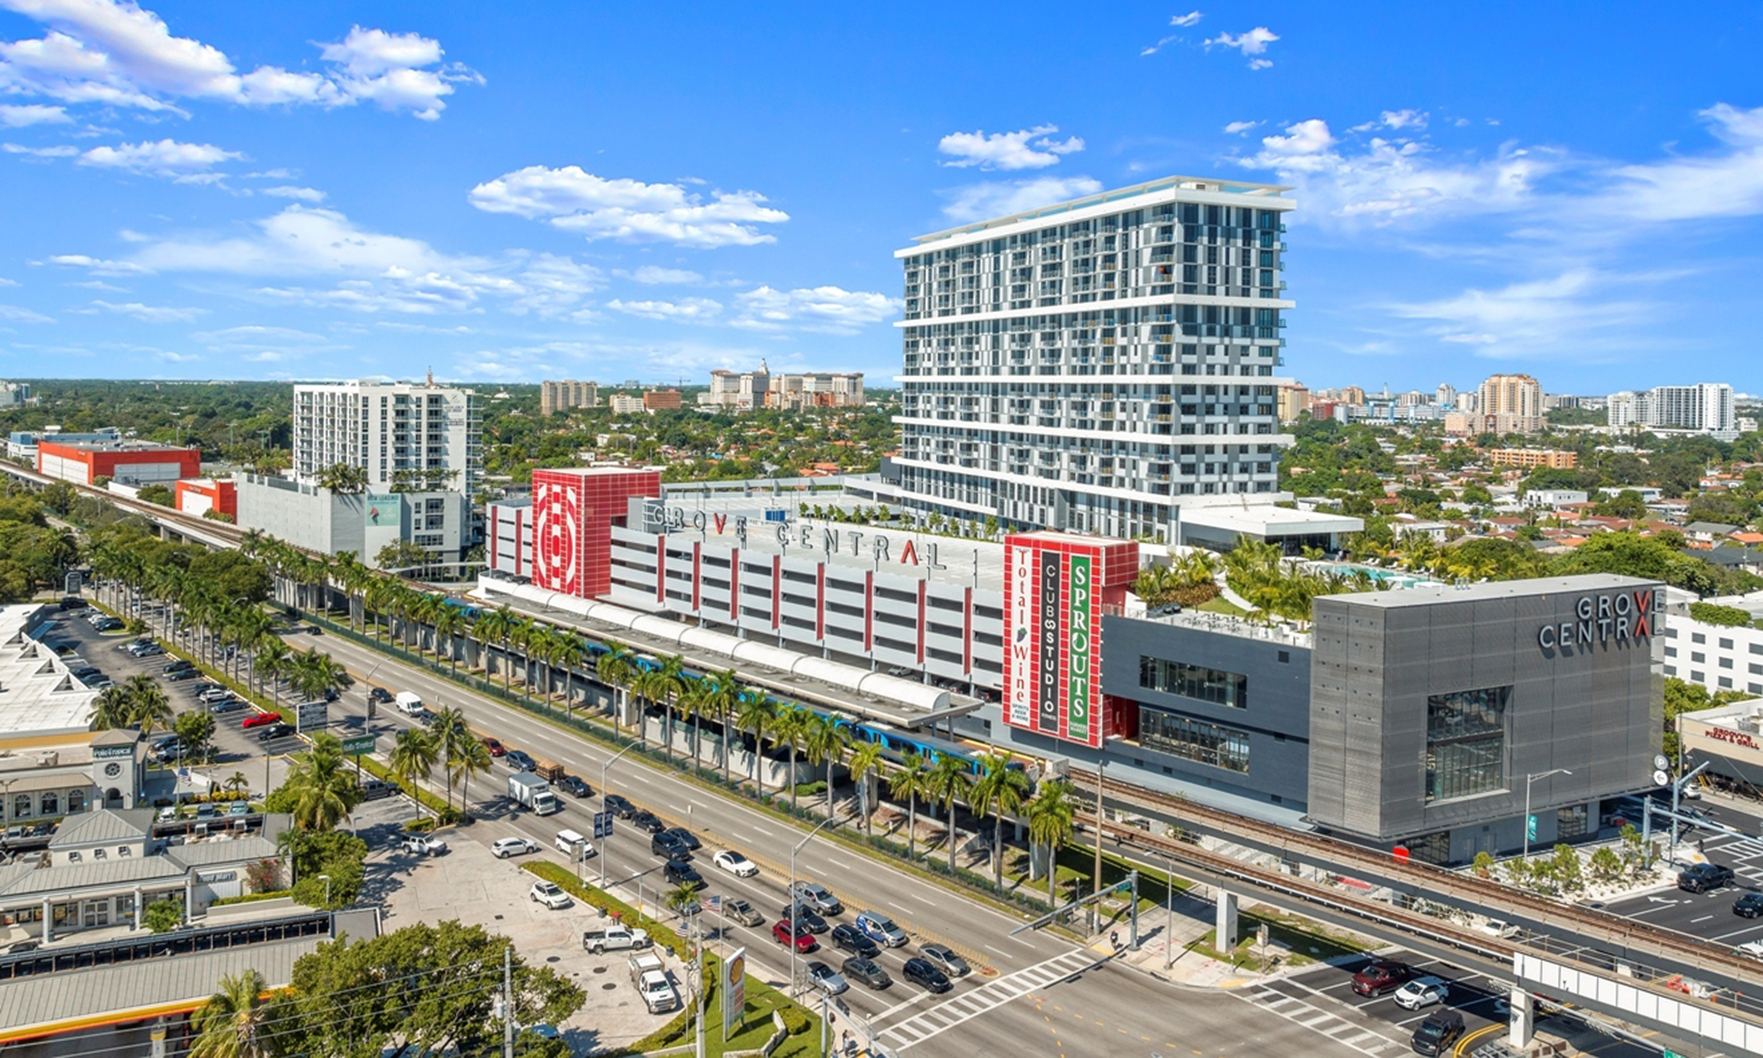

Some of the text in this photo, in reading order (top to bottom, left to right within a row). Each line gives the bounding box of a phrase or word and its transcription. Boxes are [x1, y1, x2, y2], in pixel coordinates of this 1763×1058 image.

[654, 506, 947, 570] GROVE CENTRAL
[1018, 550, 1026, 624] Total
[1577, 590, 1665, 619] GROVE
[1045, 564, 1056, 713] CLUB STUDIO
[1072, 566, 1088, 718] SPROUTS
[1539, 611, 1664, 648] CENTRAL
[1013, 644, 1029, 702] Wine
[1705, 730, 1727, 742] PIZZA
[1736, 739, 1760, 750] GRILL
